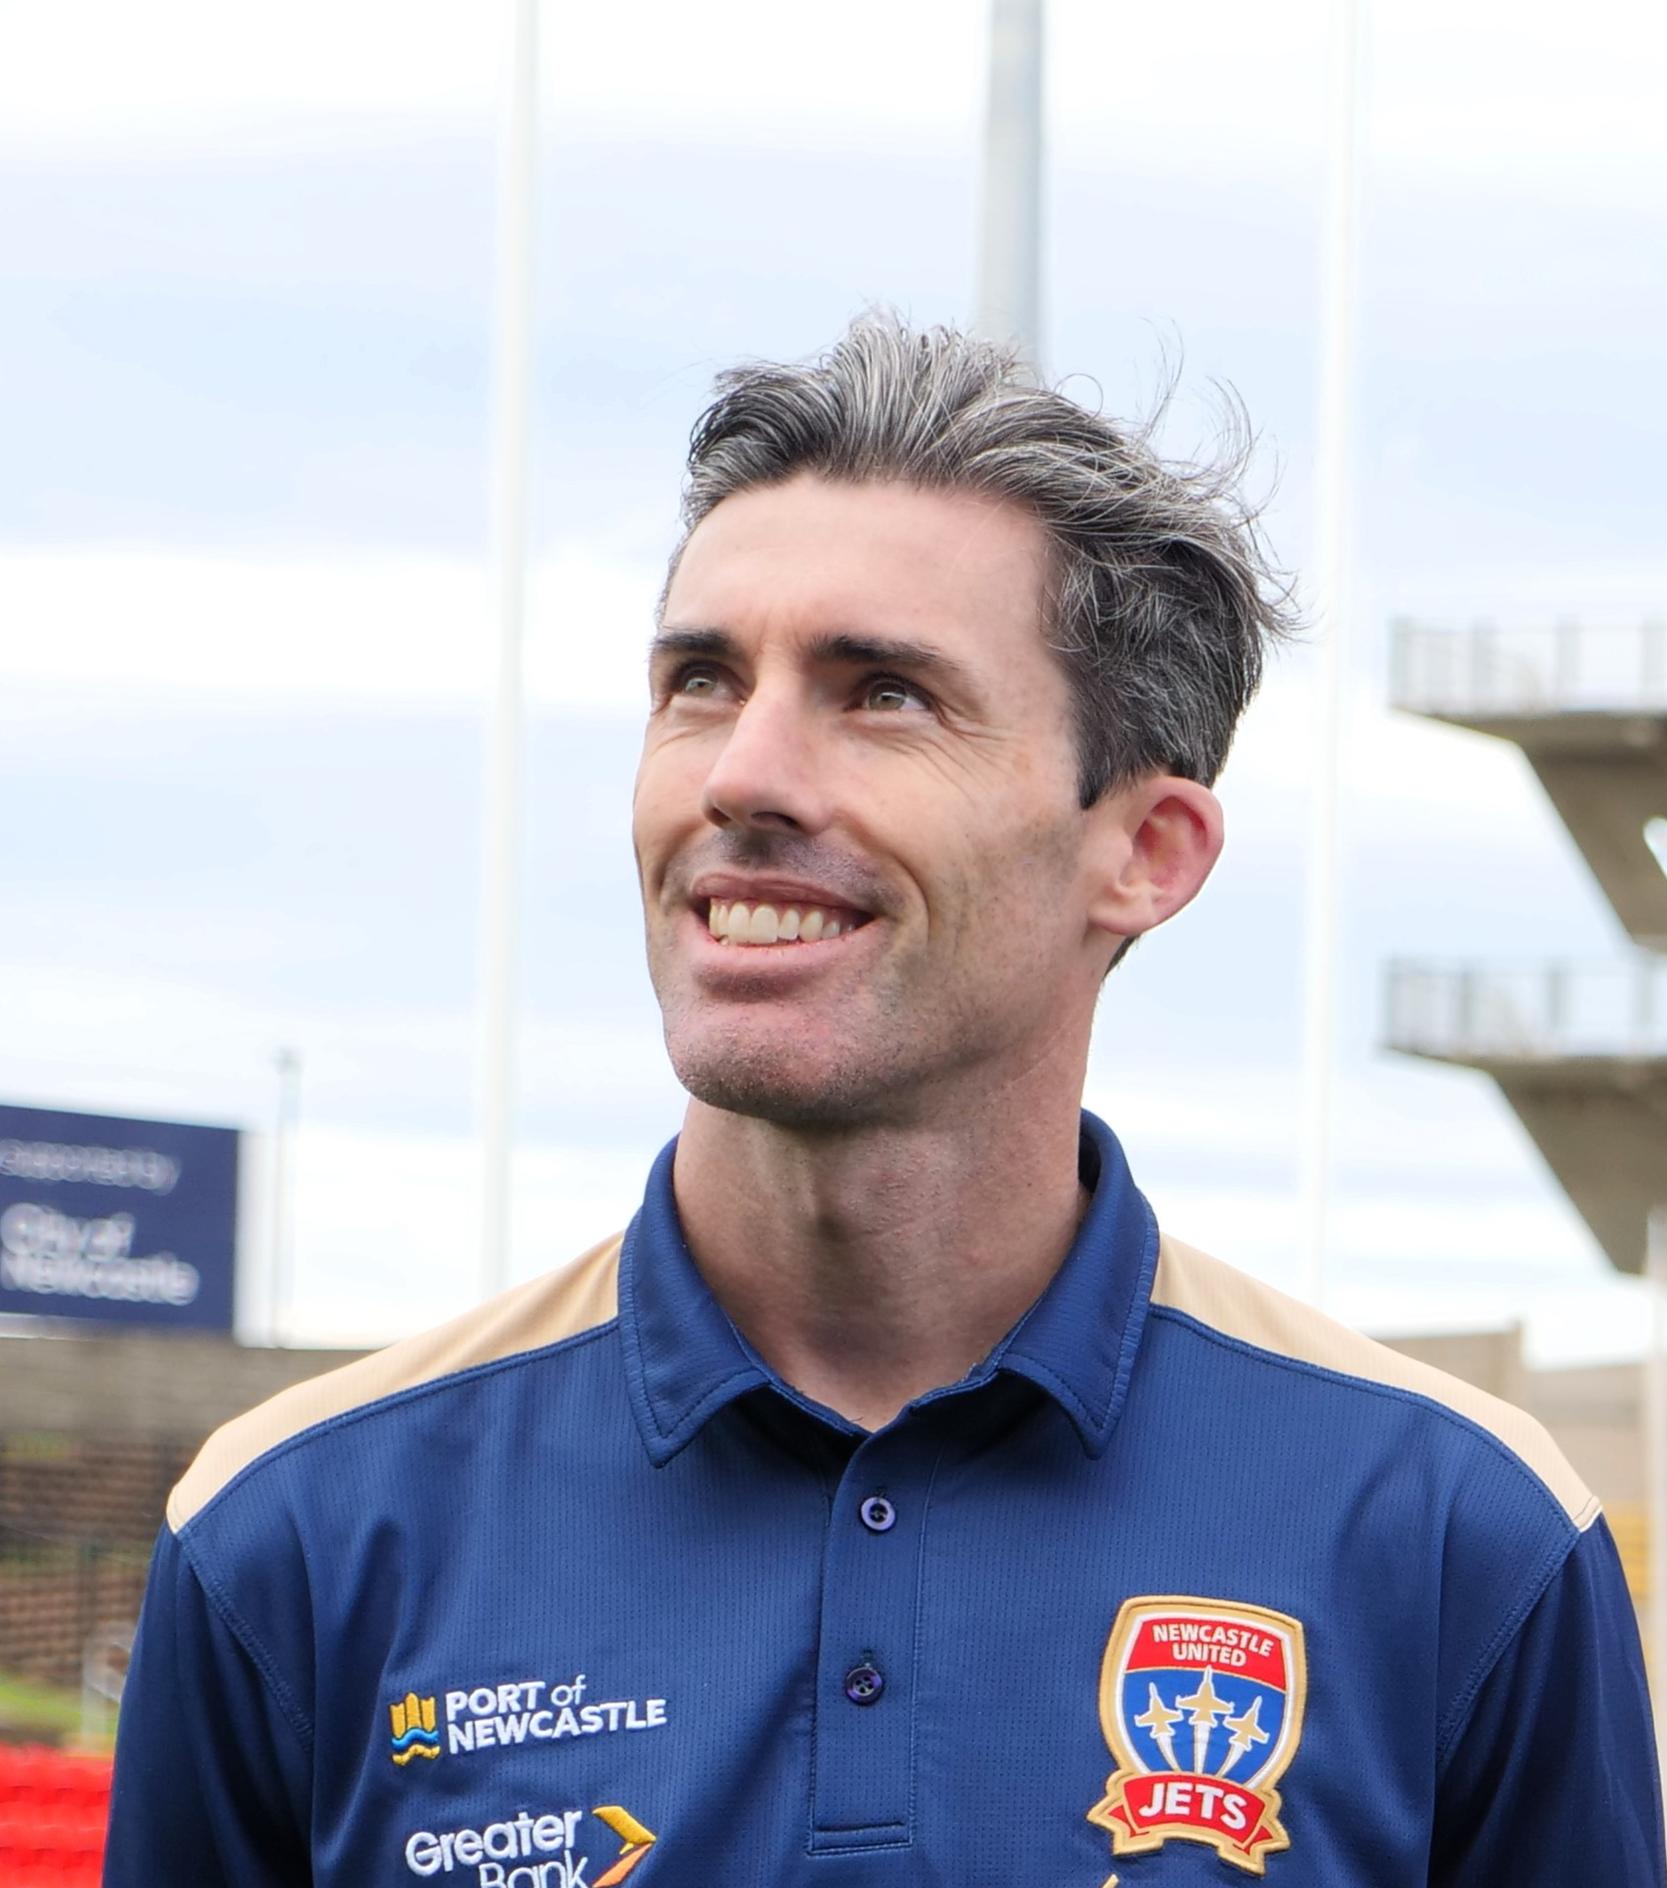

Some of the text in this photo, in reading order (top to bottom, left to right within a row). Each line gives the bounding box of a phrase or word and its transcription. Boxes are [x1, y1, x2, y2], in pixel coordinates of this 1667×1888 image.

[1152, 1623, 1274, 1657] NEWCASTLE
[1173, 1641, 1248, 1667] UNITED
[446, 1674, 587, 1723] PORT of
[448, 1698, 668, 1754] NEWCASTLE
[1138, 1782, 1248, 1831] JETS
[405, 1810, 583, 1877] Greater
